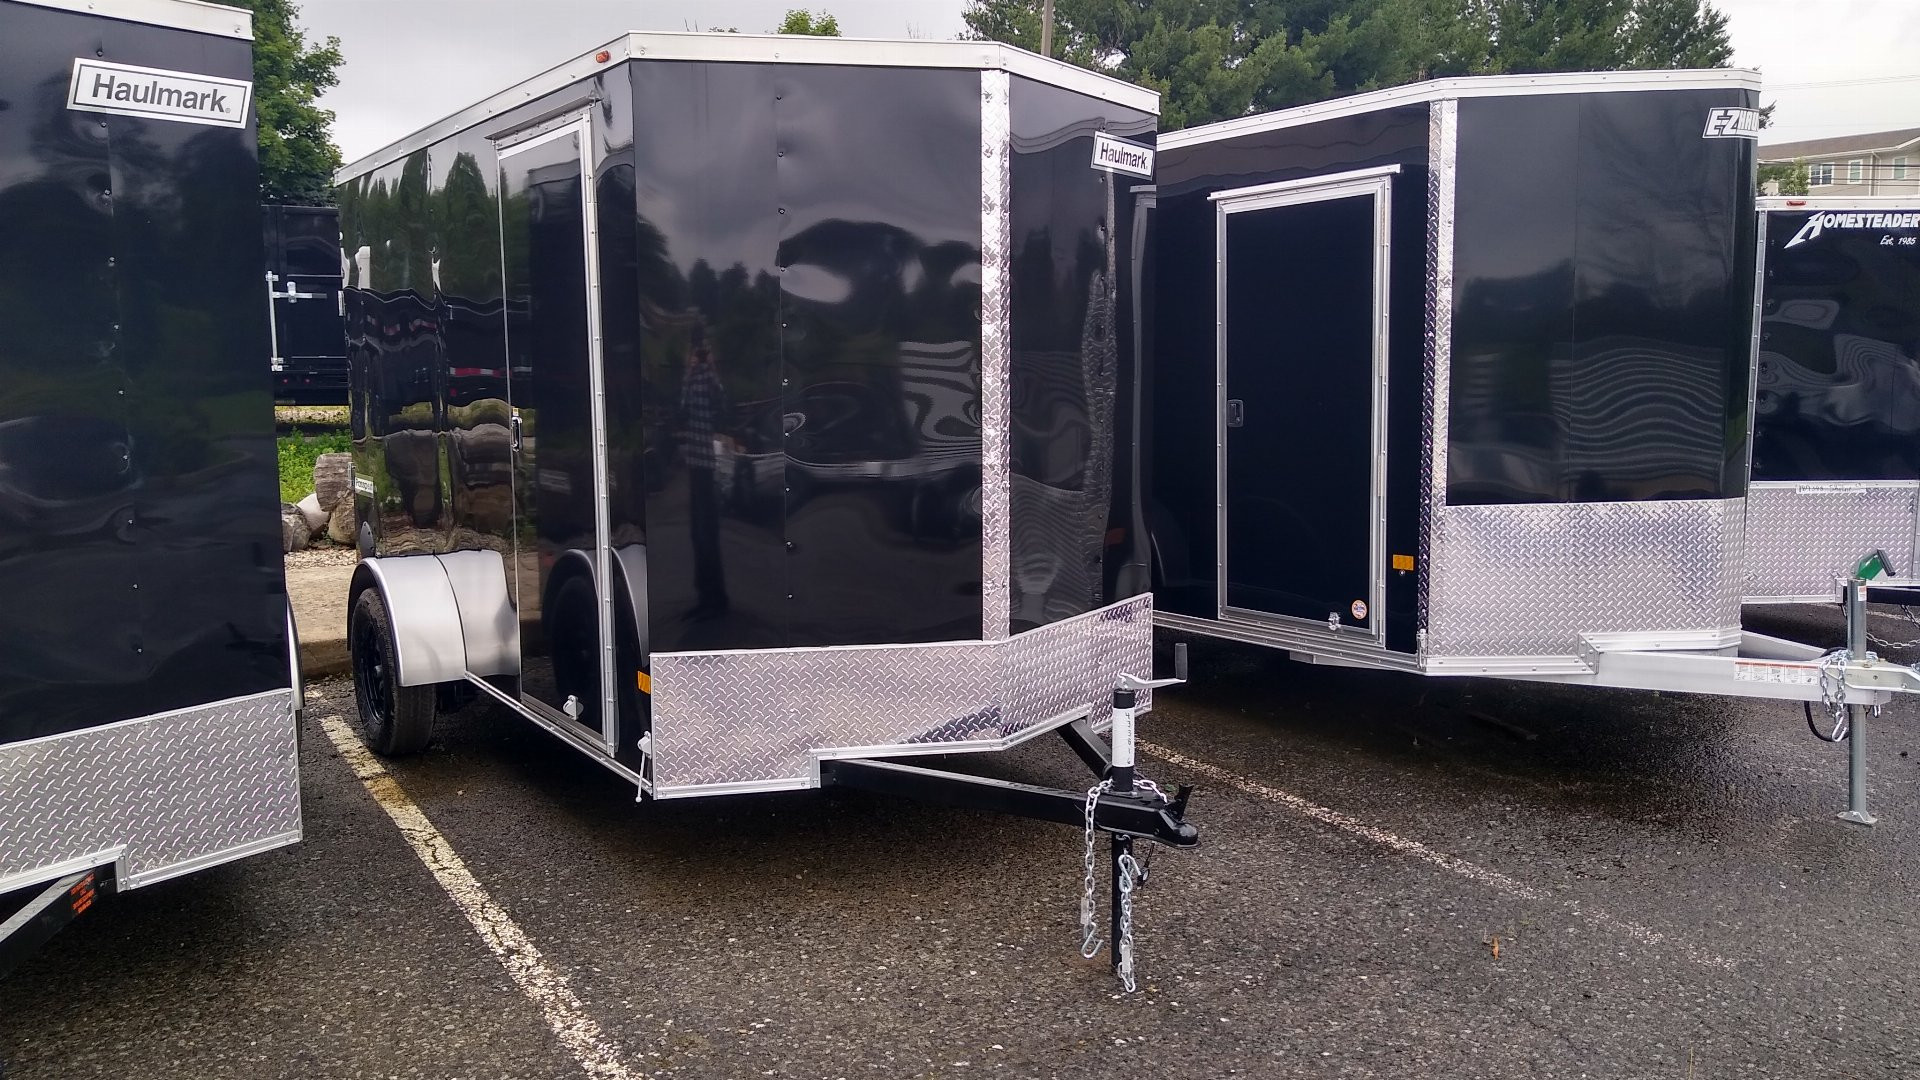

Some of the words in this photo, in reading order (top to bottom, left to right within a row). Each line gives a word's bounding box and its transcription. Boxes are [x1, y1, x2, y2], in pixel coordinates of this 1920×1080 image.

[1100, 142, 1147, 170] Haulmark
[1783, 210, 1920, 249] HOMESTEADER
[1898, 236, 1917, 245] 1985
